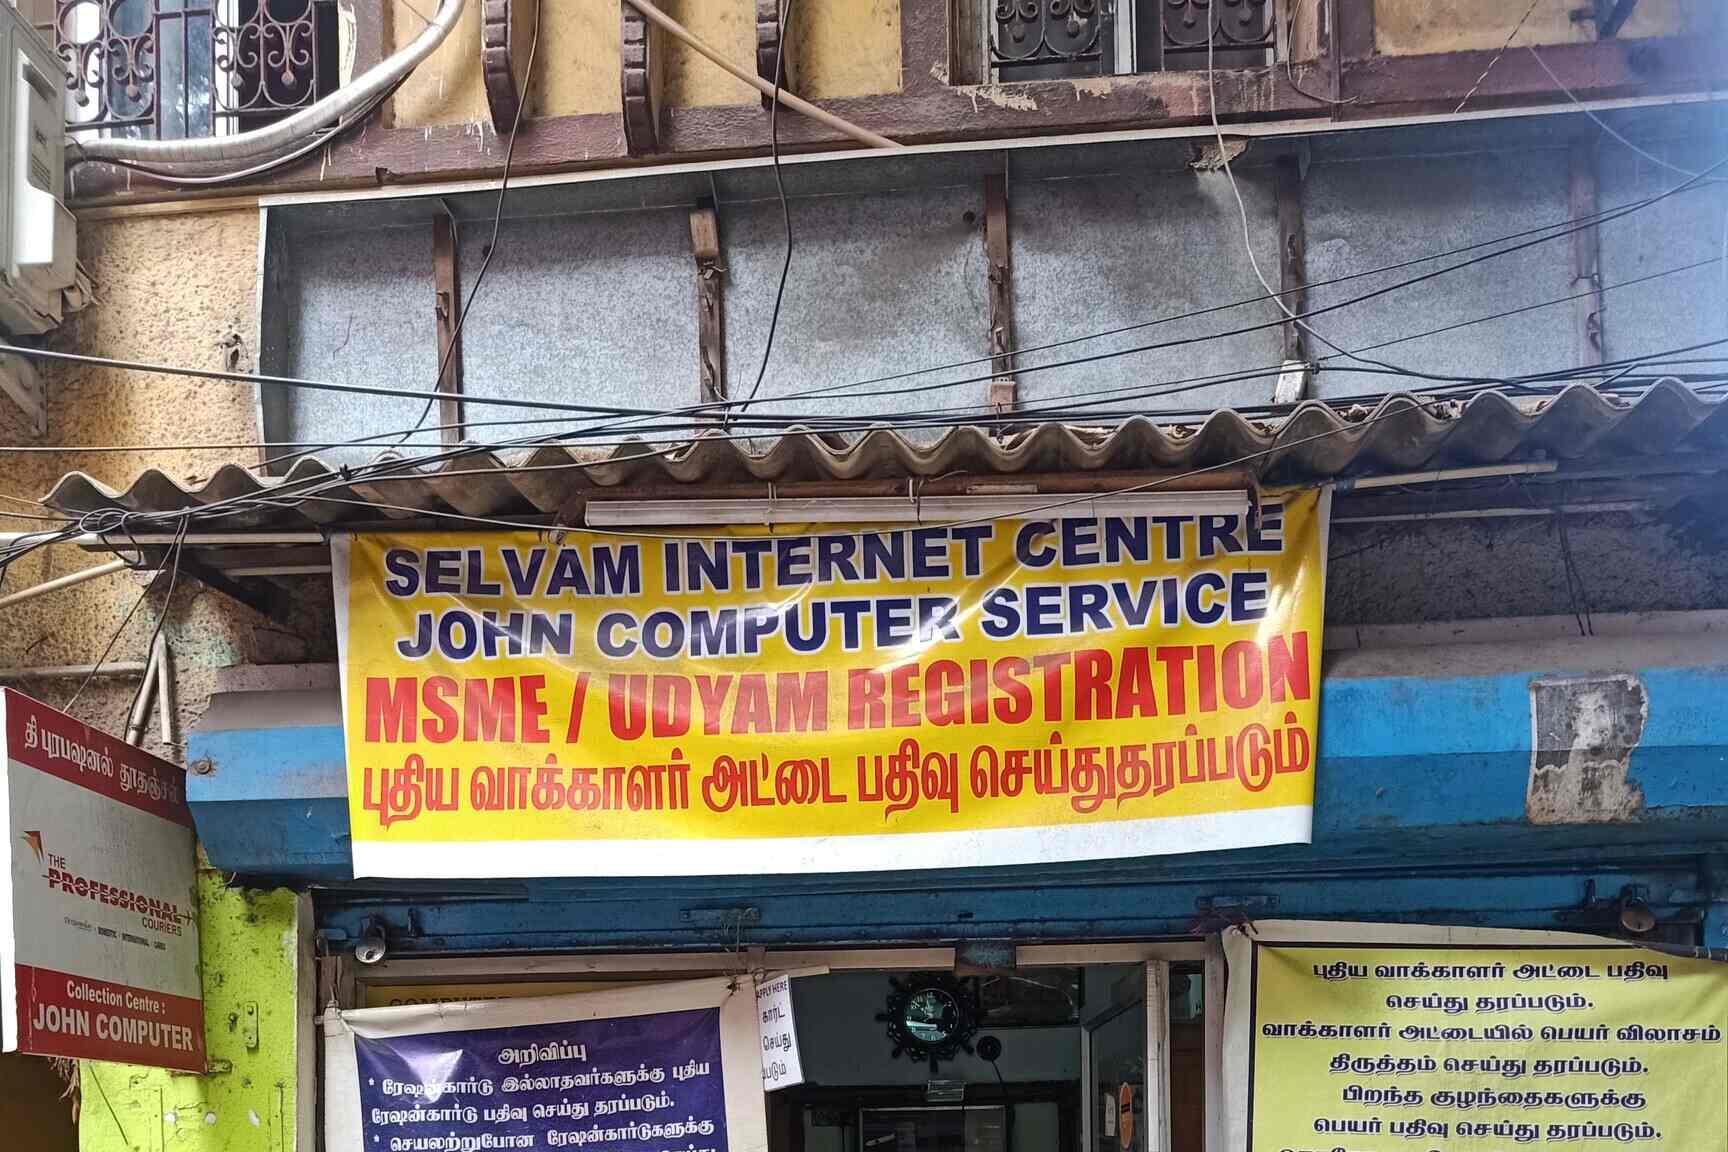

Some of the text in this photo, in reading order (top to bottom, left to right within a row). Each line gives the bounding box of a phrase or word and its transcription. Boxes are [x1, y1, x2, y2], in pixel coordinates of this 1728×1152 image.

[384, 503, 1287, 598] SELVAM INTERNET CENTRE
[397, 570, 1269, 658] JOHN COMPUTER SERVICE
[364, 631, 1311, 744] MSME / UDYAM REGISTRATION
[363, 752, 459, 829] புதிய
[471, 747, 691, 811] வாக்காளர்
[701, 752, 847, 813] அட்டை
[858, 737, 960, 819] பதிவு
[48, 853, 66, 869] THE
[48, 868, 182, 924] PROFESSIONAL
[141, 917, 183, 937] COURIERS
[1313, 959, 1670, 983] புதிய வாக்காளர் அட்டை பதிவு
[66, 979, 122, 1004] Collection
[123, 992, 160, 1013] Centre
[772, 980, 788, 994] HERE
[1385, 993, 1469, 1014] செய்து
[33, 1004, 194, 1052] JOHN COMPUTER
[1261, 1020, 1722, 1045] வாக்காளர் அட்டையில் பெயர் விலாசம்
[498, 1040, 588, 1068] அறிவிப்பு
[1328, 1053, 1438, 1076] திருத்தம்
[1443, 1055, 1528, 1077] செய்து
[501, 1063, 666, 1093] இல்லாதவர்களுக்கு
[672, 1058, 711, 1082] புதிய
[1341, 1084, 1648, 1110] பிறந்த குழந்தைகளுக்கு
[371, 1103, 479, 1126] ரேஷன்கார்டு
[483, 1103, 528, 1125] பதிவு
[533, 1098, 589, 1120] செய்து
[547, 1115, 715, 1147] ரேஷன்கார்டுகளுக்கு
[1313, 1116, 1385, 1138] பெயர்
[1389, 1118, 1450, 1140] பதிவு
[1455, 1118, 1541, 1141] செய்து
